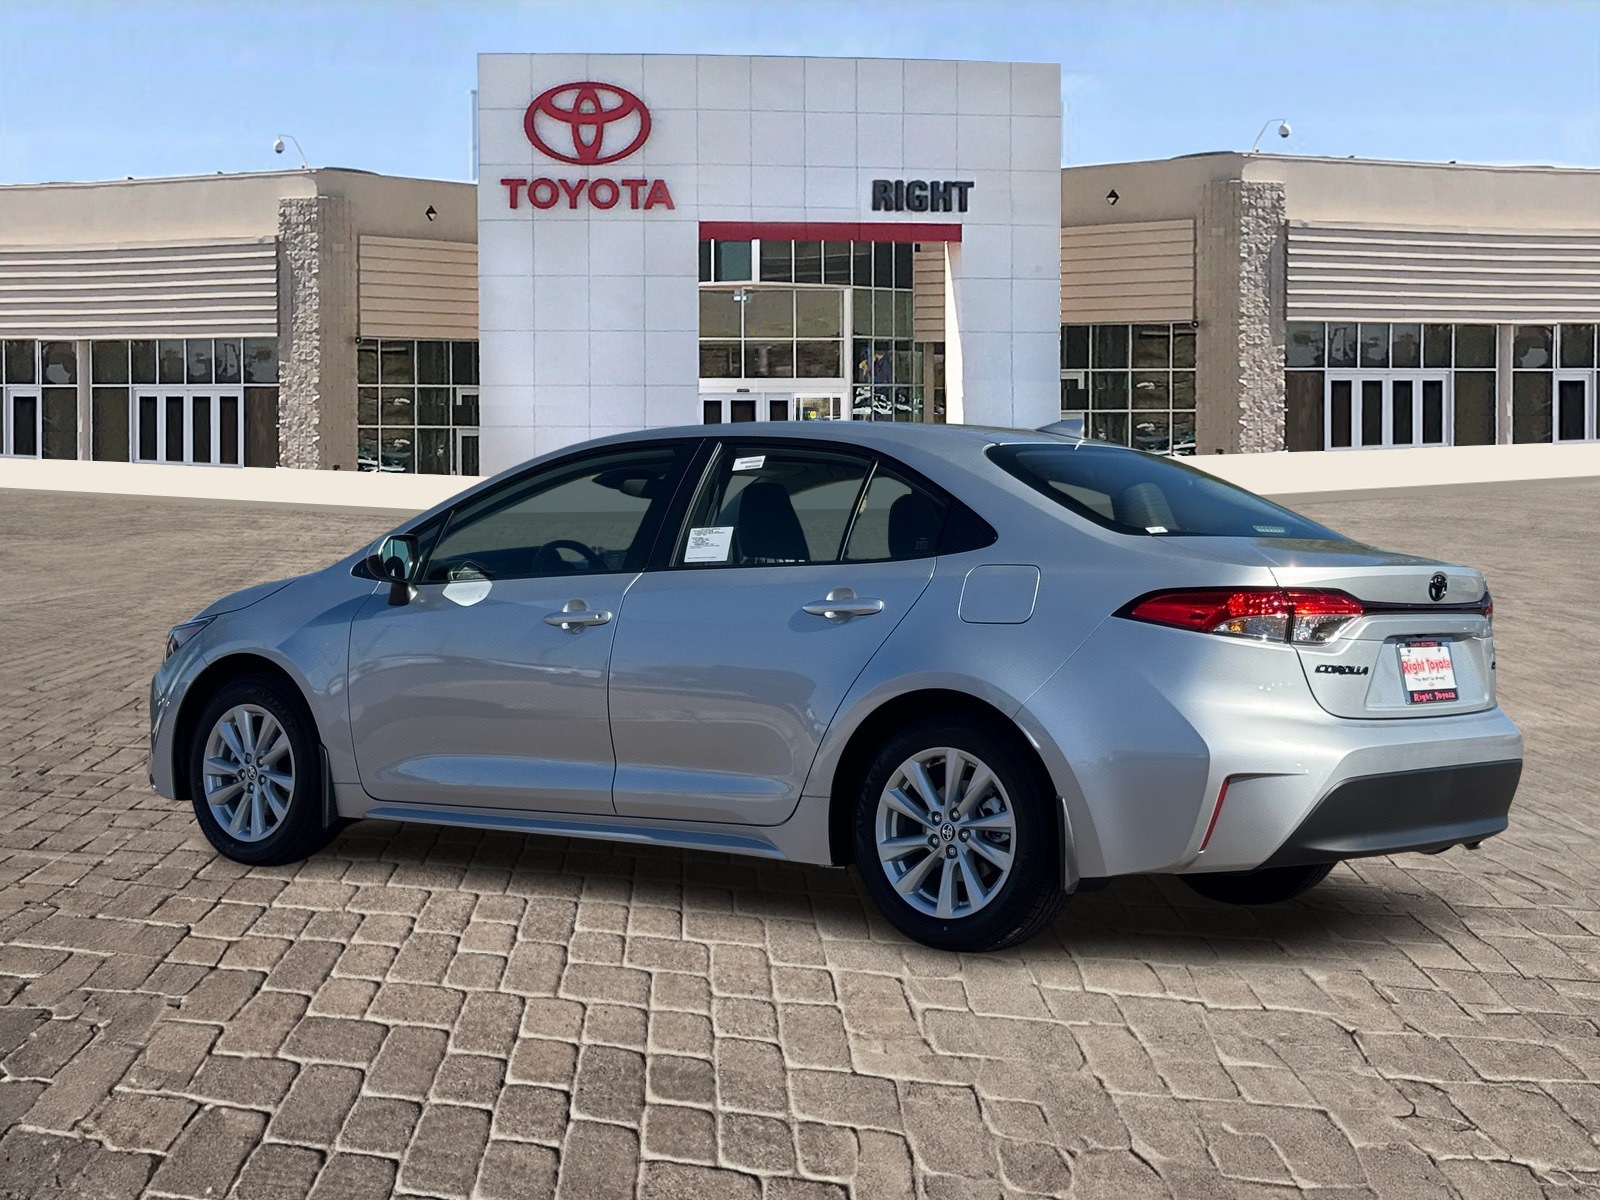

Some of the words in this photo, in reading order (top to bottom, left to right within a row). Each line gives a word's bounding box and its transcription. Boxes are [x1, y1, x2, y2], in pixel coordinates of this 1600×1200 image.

[501, 178, 675, 209] TOYOTA
[872, 180, 975, 212] RIGHT
[1315, 664, 1369, 675] COROLLA
[1402, 659, 1425, 674] Right
[1426, 659, 1451, 673] Toyota
[1413, 692, 1433, 702] Right
[1435, 692, 1456, 700] Toyota
